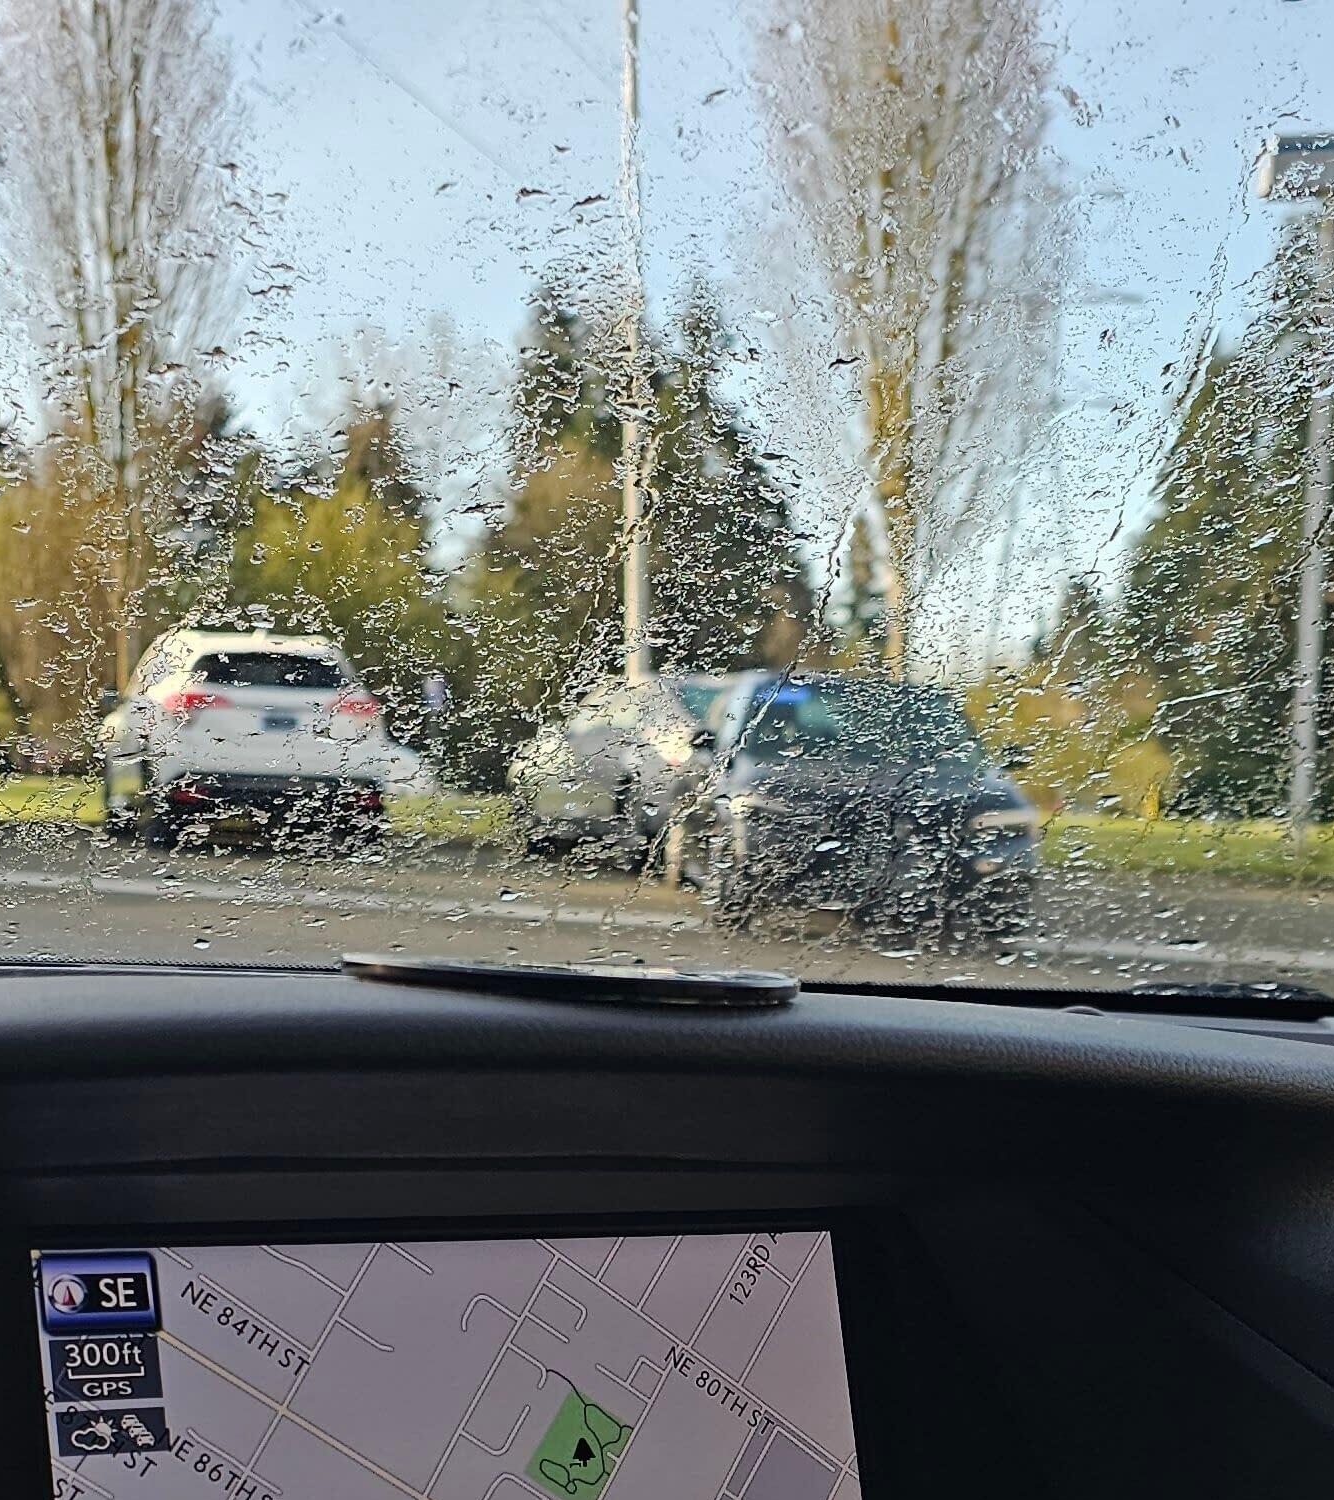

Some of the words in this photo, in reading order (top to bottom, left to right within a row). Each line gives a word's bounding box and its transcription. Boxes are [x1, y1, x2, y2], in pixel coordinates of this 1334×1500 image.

[729, 1244, 770, 1305] 123RD
[98, 1277, 138, 1308] SE
[180, 1280, 217, 1315] NE
[216, 1305, 279, 1358] 84TH
[279, 1347, 311, 1377] ST
[65, 1343, 143, 1368] 300ft
[82, 1381, 133, 1397] GPS
[664, 1346, 695, 1378] NE
[695, 1371, 747, 1419] 80TH
[747, 1408, 775, 1437] ST
[158, 1428, 193, 1463] NE
